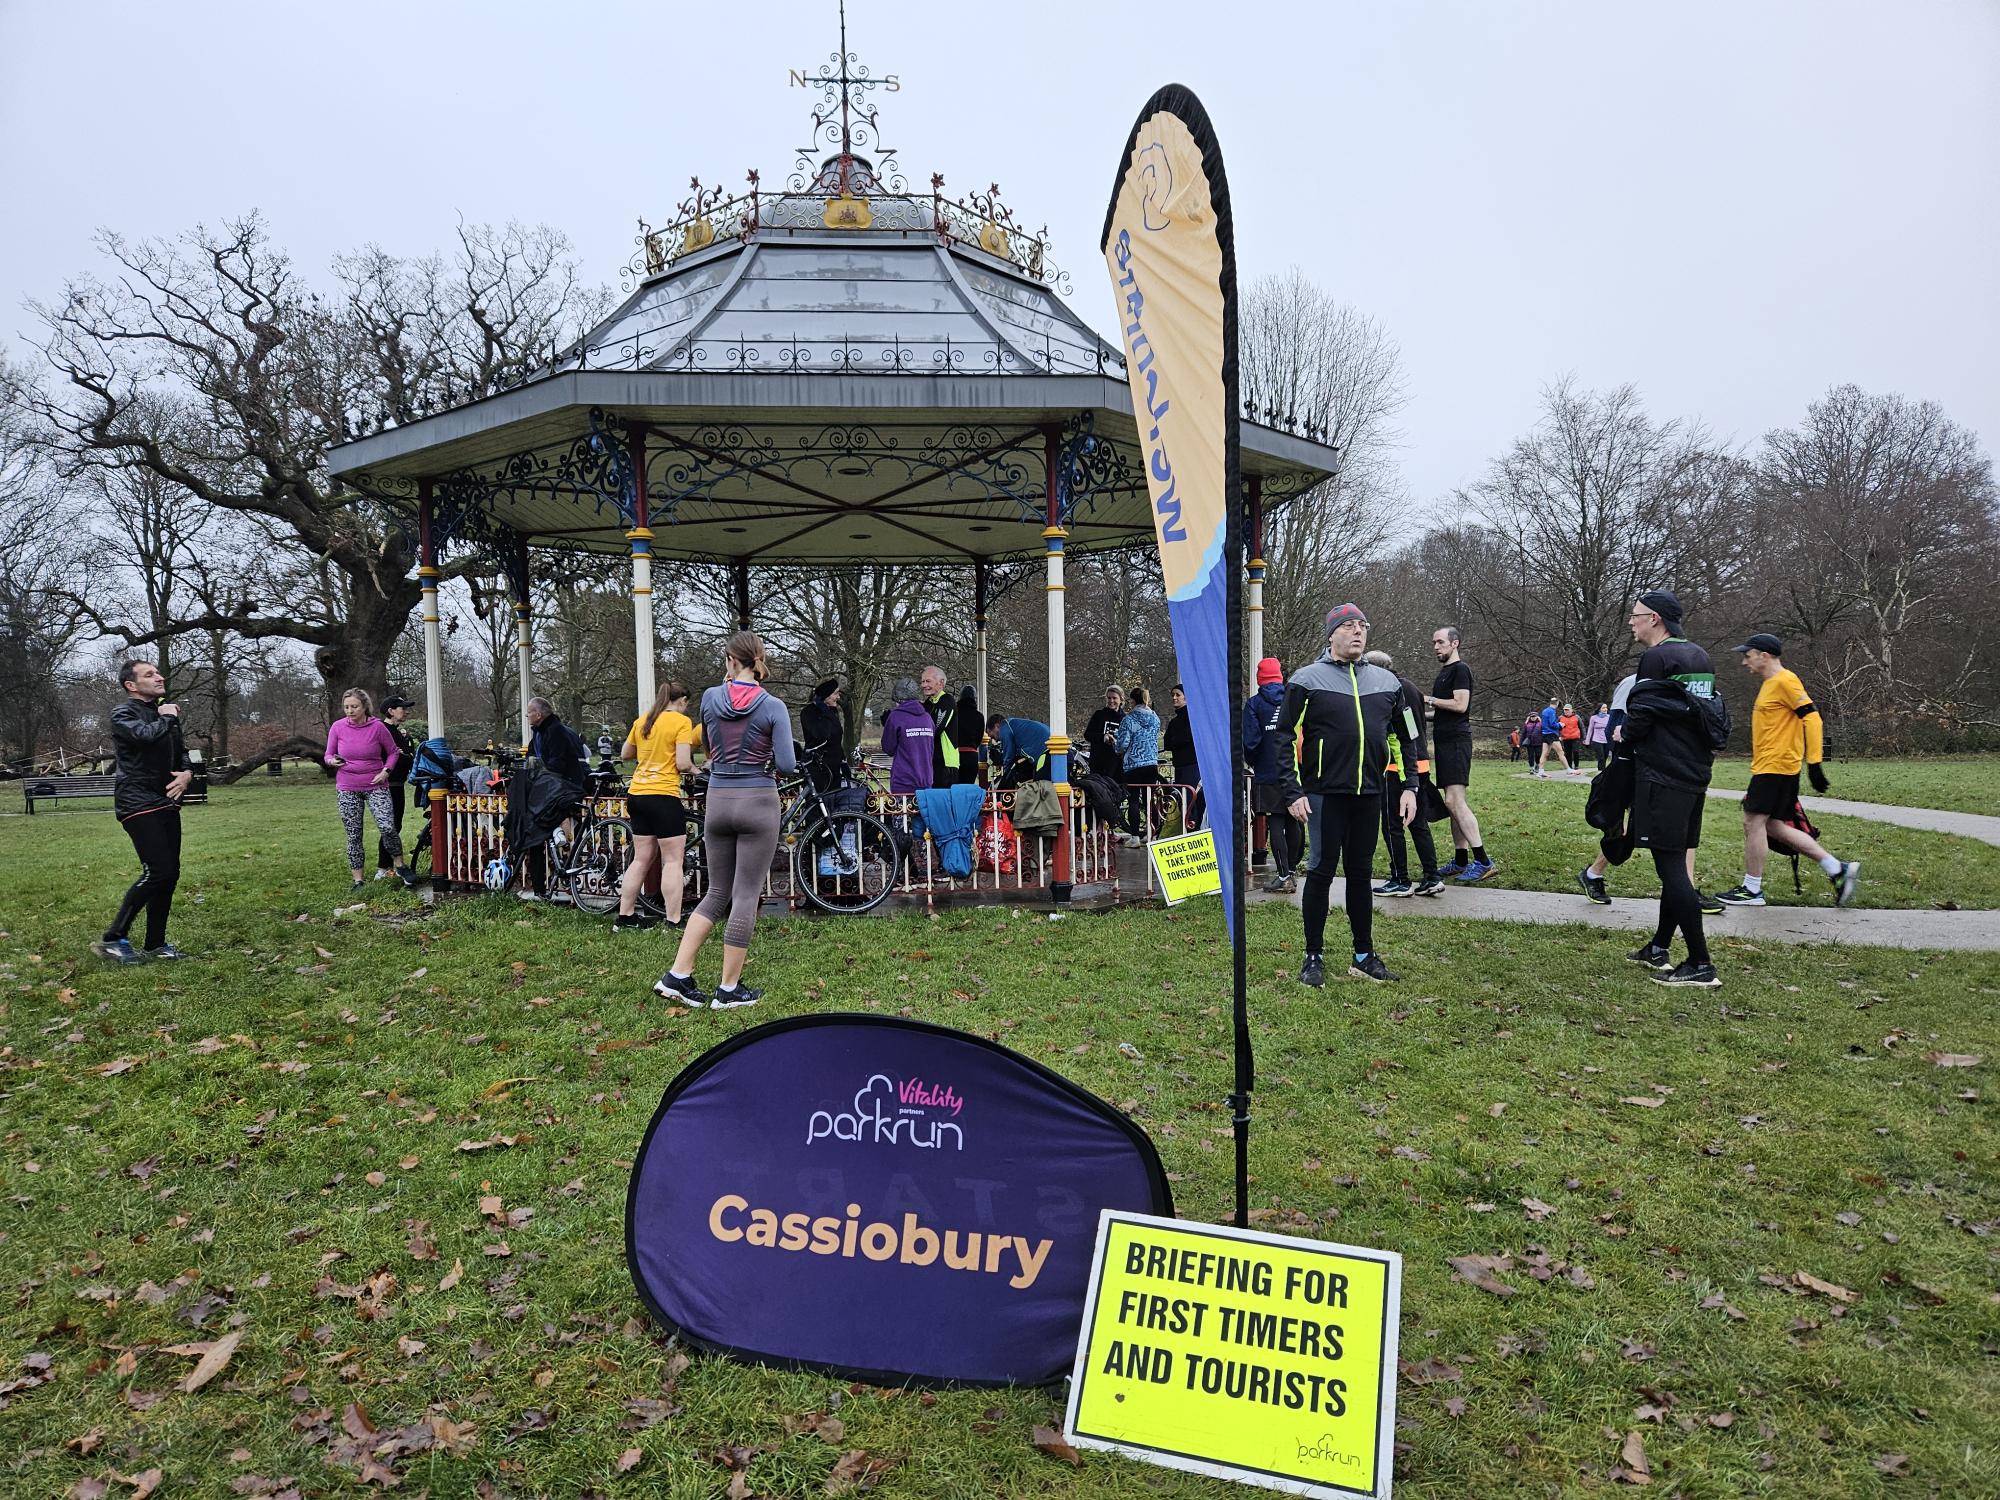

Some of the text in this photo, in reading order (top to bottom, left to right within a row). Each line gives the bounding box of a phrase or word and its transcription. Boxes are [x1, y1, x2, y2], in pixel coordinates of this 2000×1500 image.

[789, 69, 807, 88] N
[884, 75, 901, 92] S
[1158, 837, 1210, 857] PLEASE DON'T
[1166, 850, 1211, 869] TAKE FINISH
[1166, 861, 1219, 882] TOKENS HOME
[806, 1074, 964, 1151] parkrun
[899, 1077, 963, 1117] Vitality
[899, 1107, 925, 1116] partners
[708, 1194, 1054, 1290] Cassiobury
[1124, 1242, 1349, 1309] BRIEFING FOR
[1118, 1290, 1345, 1361] FIRST TIMERS
[1102, 1340, 1348, 1417] AND TOURISTS
[1295, 1433, 1361, 1467] parkrun
